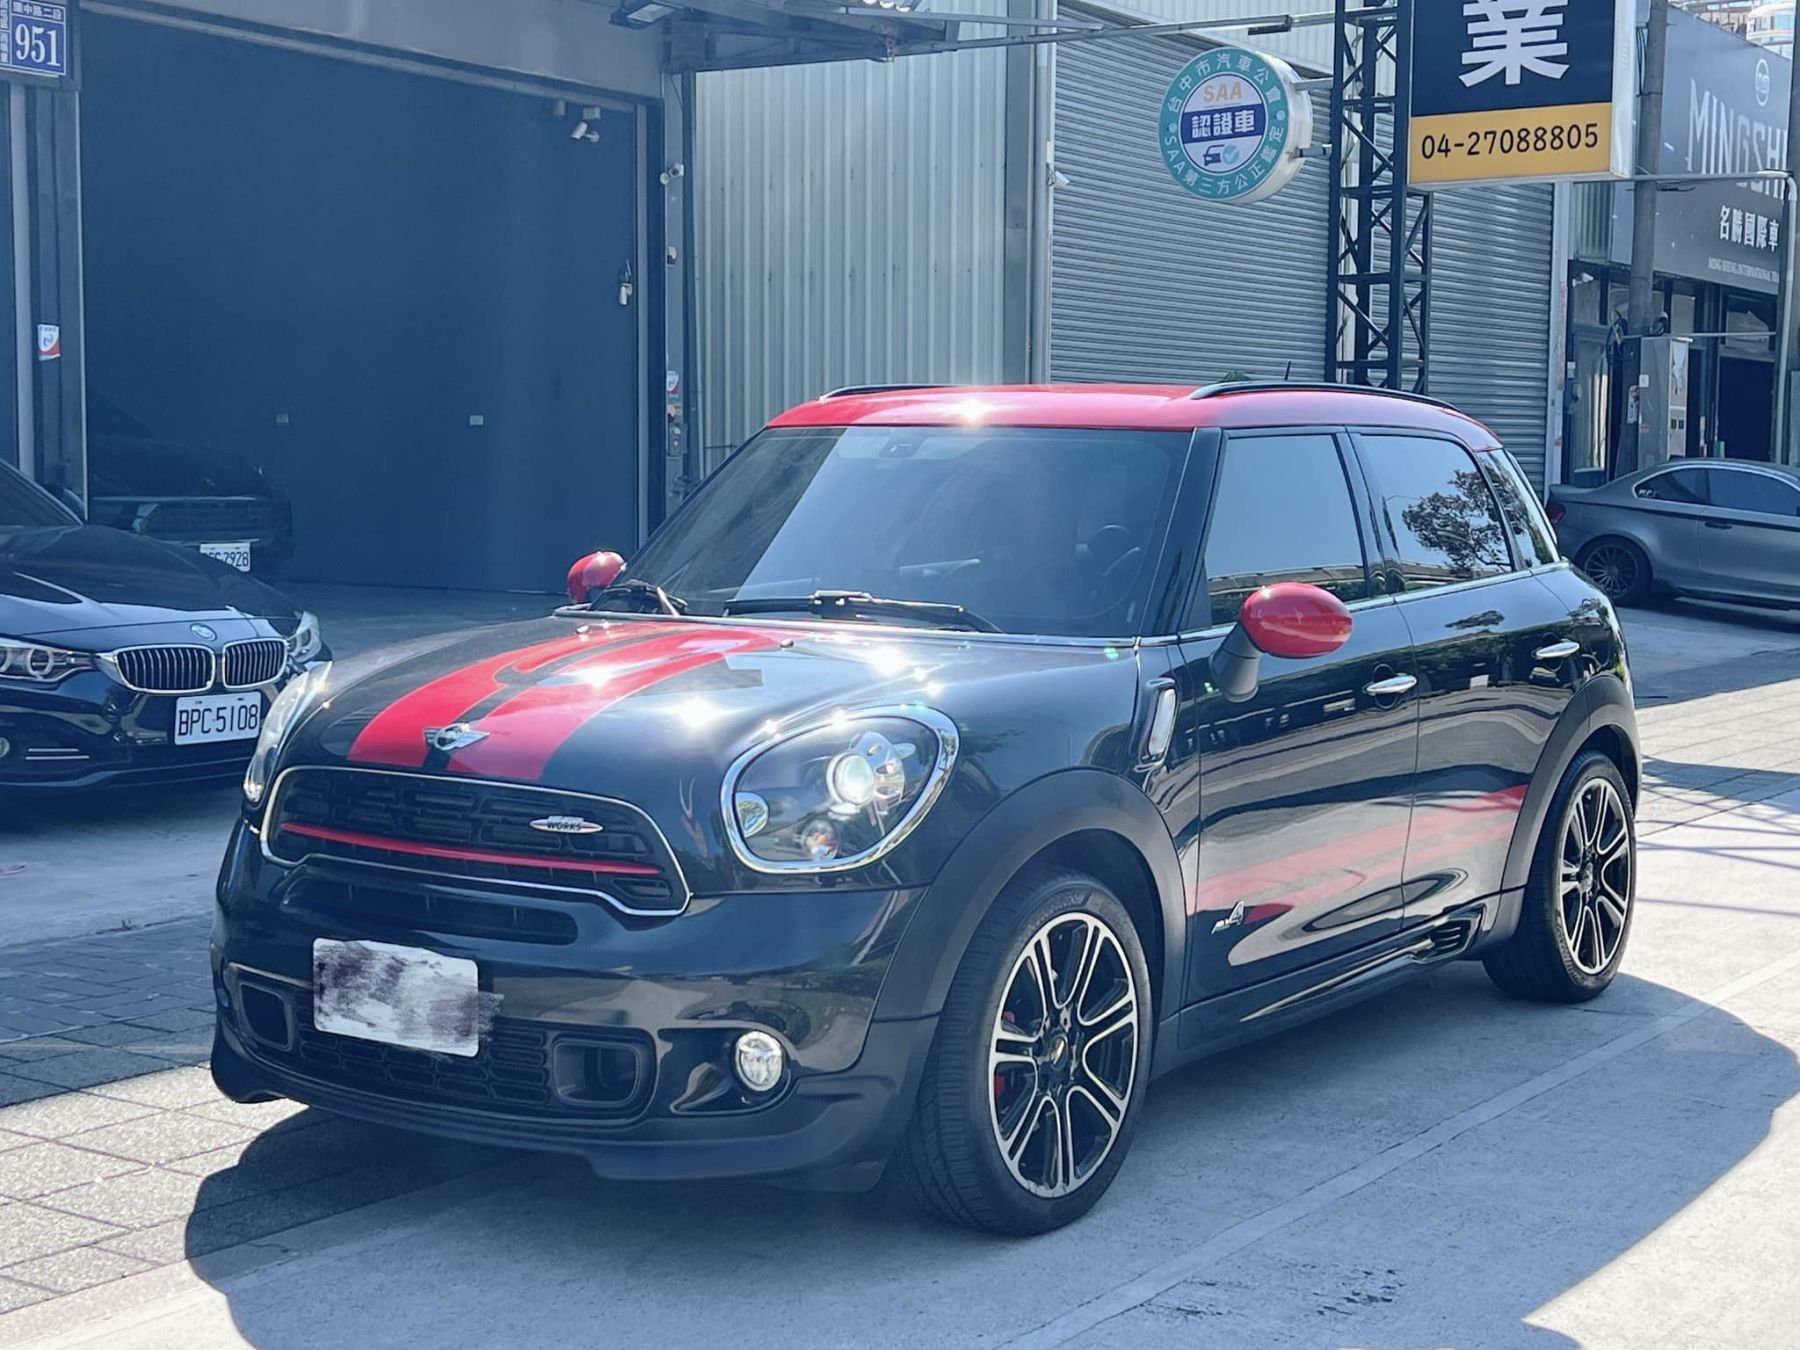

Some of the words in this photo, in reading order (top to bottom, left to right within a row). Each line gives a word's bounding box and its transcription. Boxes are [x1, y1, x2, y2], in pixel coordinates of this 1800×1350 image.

[15, 23, 61, 67] 951
[1458, 0, 1570, 88] 業
[1203, 81, 1243, 102] SAA
[1191, 110, 1255, 139] 認證車
[1421, 123, 1598, 159] 04-27088805
